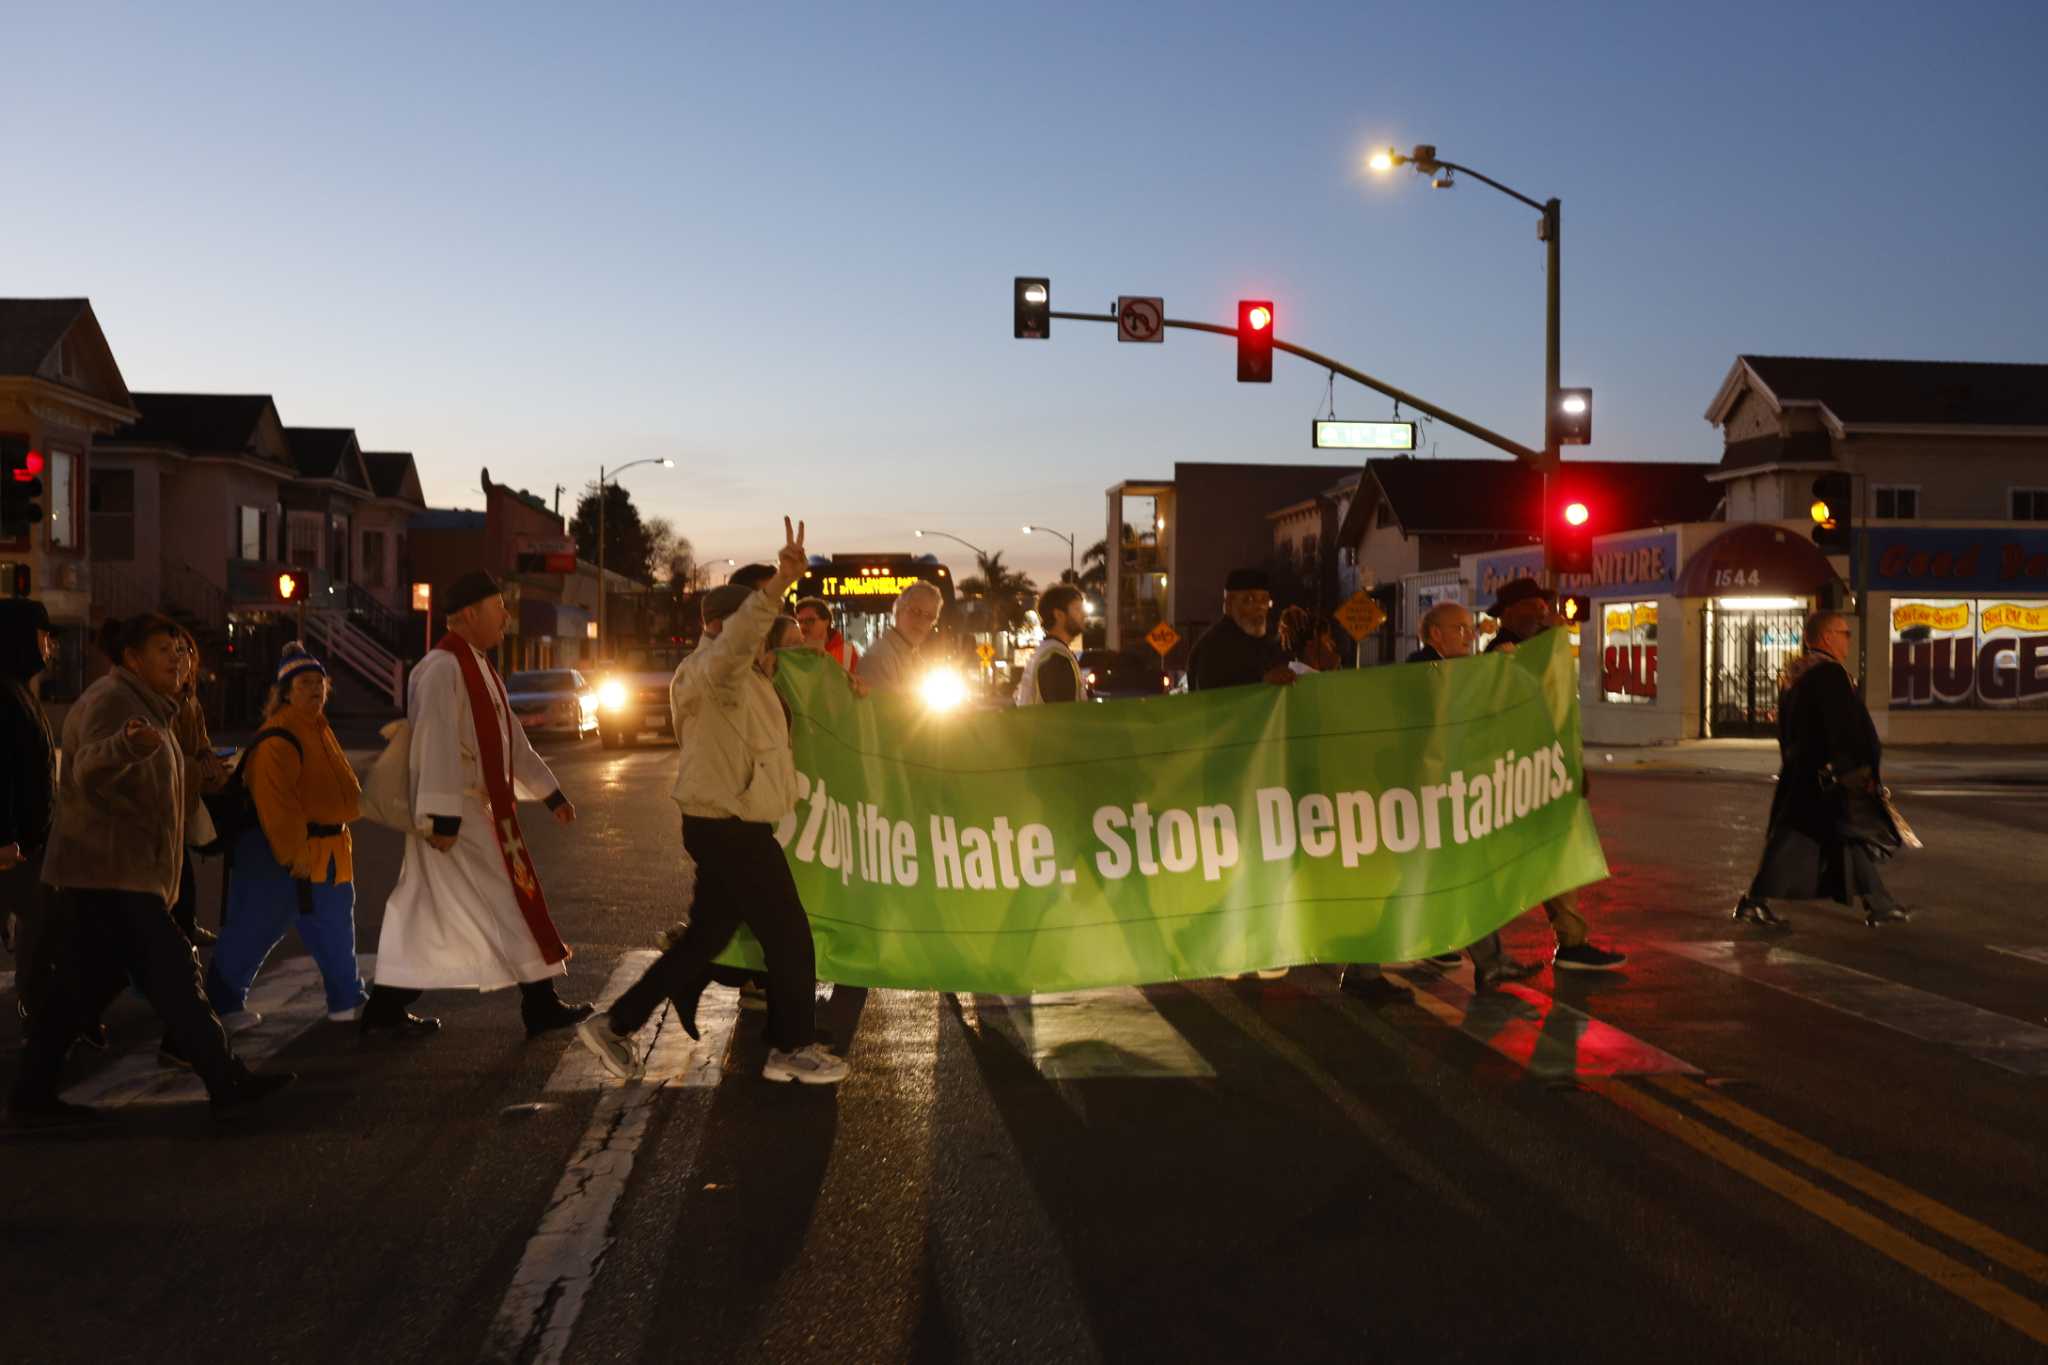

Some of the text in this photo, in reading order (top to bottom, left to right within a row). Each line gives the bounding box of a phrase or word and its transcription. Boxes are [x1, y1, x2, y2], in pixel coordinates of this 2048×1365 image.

[1715, 568, 1760, 587] 1544
[1891, 635, 2048, 702] HUGE
[857, 800, 919, 887] the
[930, 814, 1077, 890] Hate.
[1092, 802, 1239, 881] Stop
[1256, 739, 1573, 867] Deportations.
